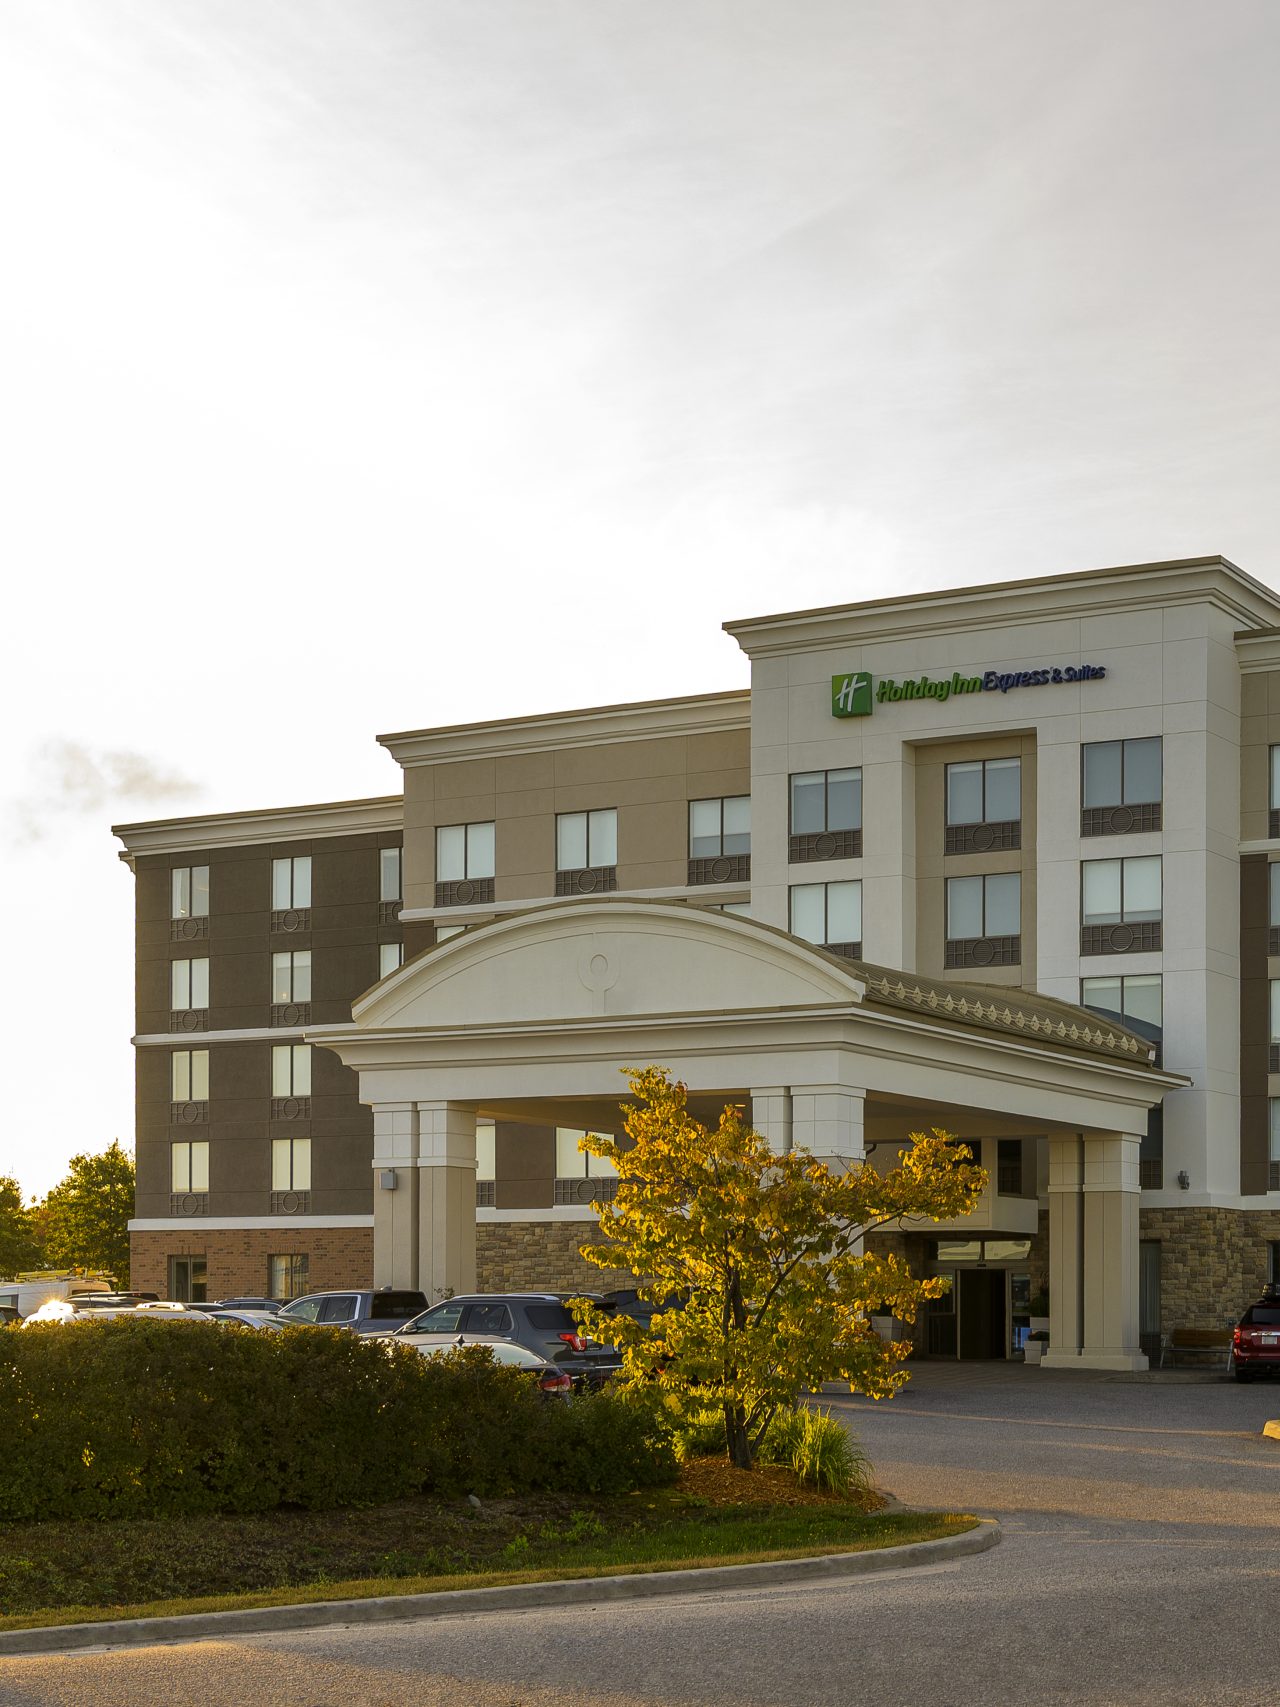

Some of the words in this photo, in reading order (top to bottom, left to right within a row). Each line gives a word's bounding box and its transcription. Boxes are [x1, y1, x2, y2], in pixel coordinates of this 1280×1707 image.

[876, 676, 951, 703] Holiday
[952, 672, 982, 695] Inn
[982, 669, 1049, 693] Express
[1051, 667, 1063, 684] &
[1064, 664, 1106, 683] Suites
